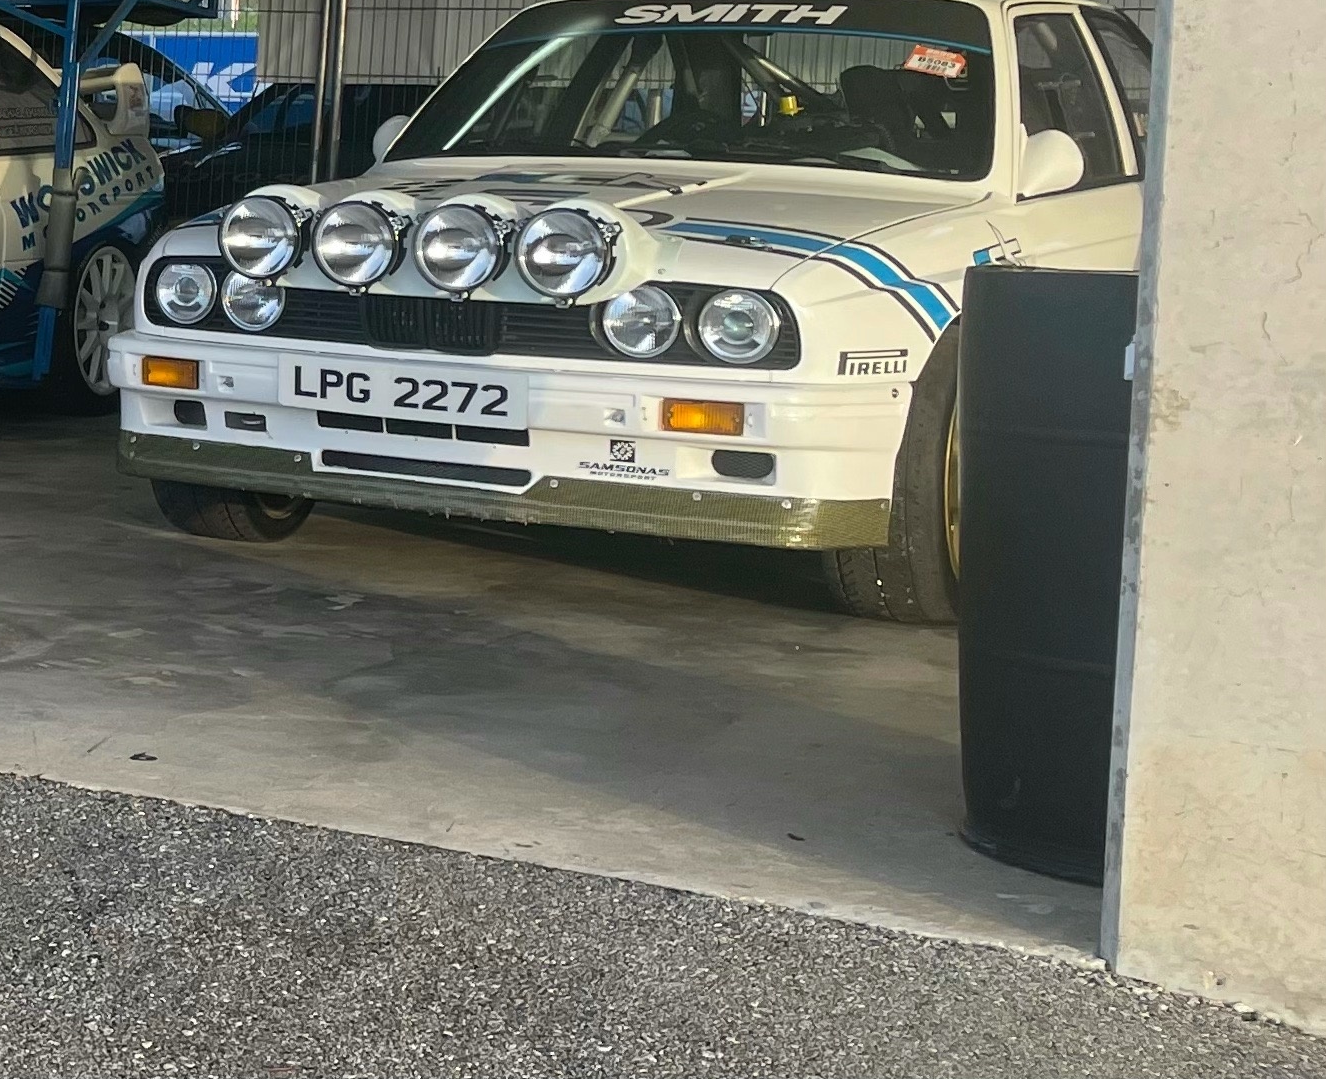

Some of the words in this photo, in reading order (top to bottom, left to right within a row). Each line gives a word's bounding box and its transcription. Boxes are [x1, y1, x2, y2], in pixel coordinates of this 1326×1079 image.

[614, 3, 849, 25] SMITH
[11, 138, 147, 229] WOSWICK
[22, 165, 155, 252] MORSPORT
[837, 349, 909, 375] PIRELLI
[294, 366, 371, 403] LPG
[394, 377, 508, 417] 2272
[578, 461, 670, 476] SAMSONAS
